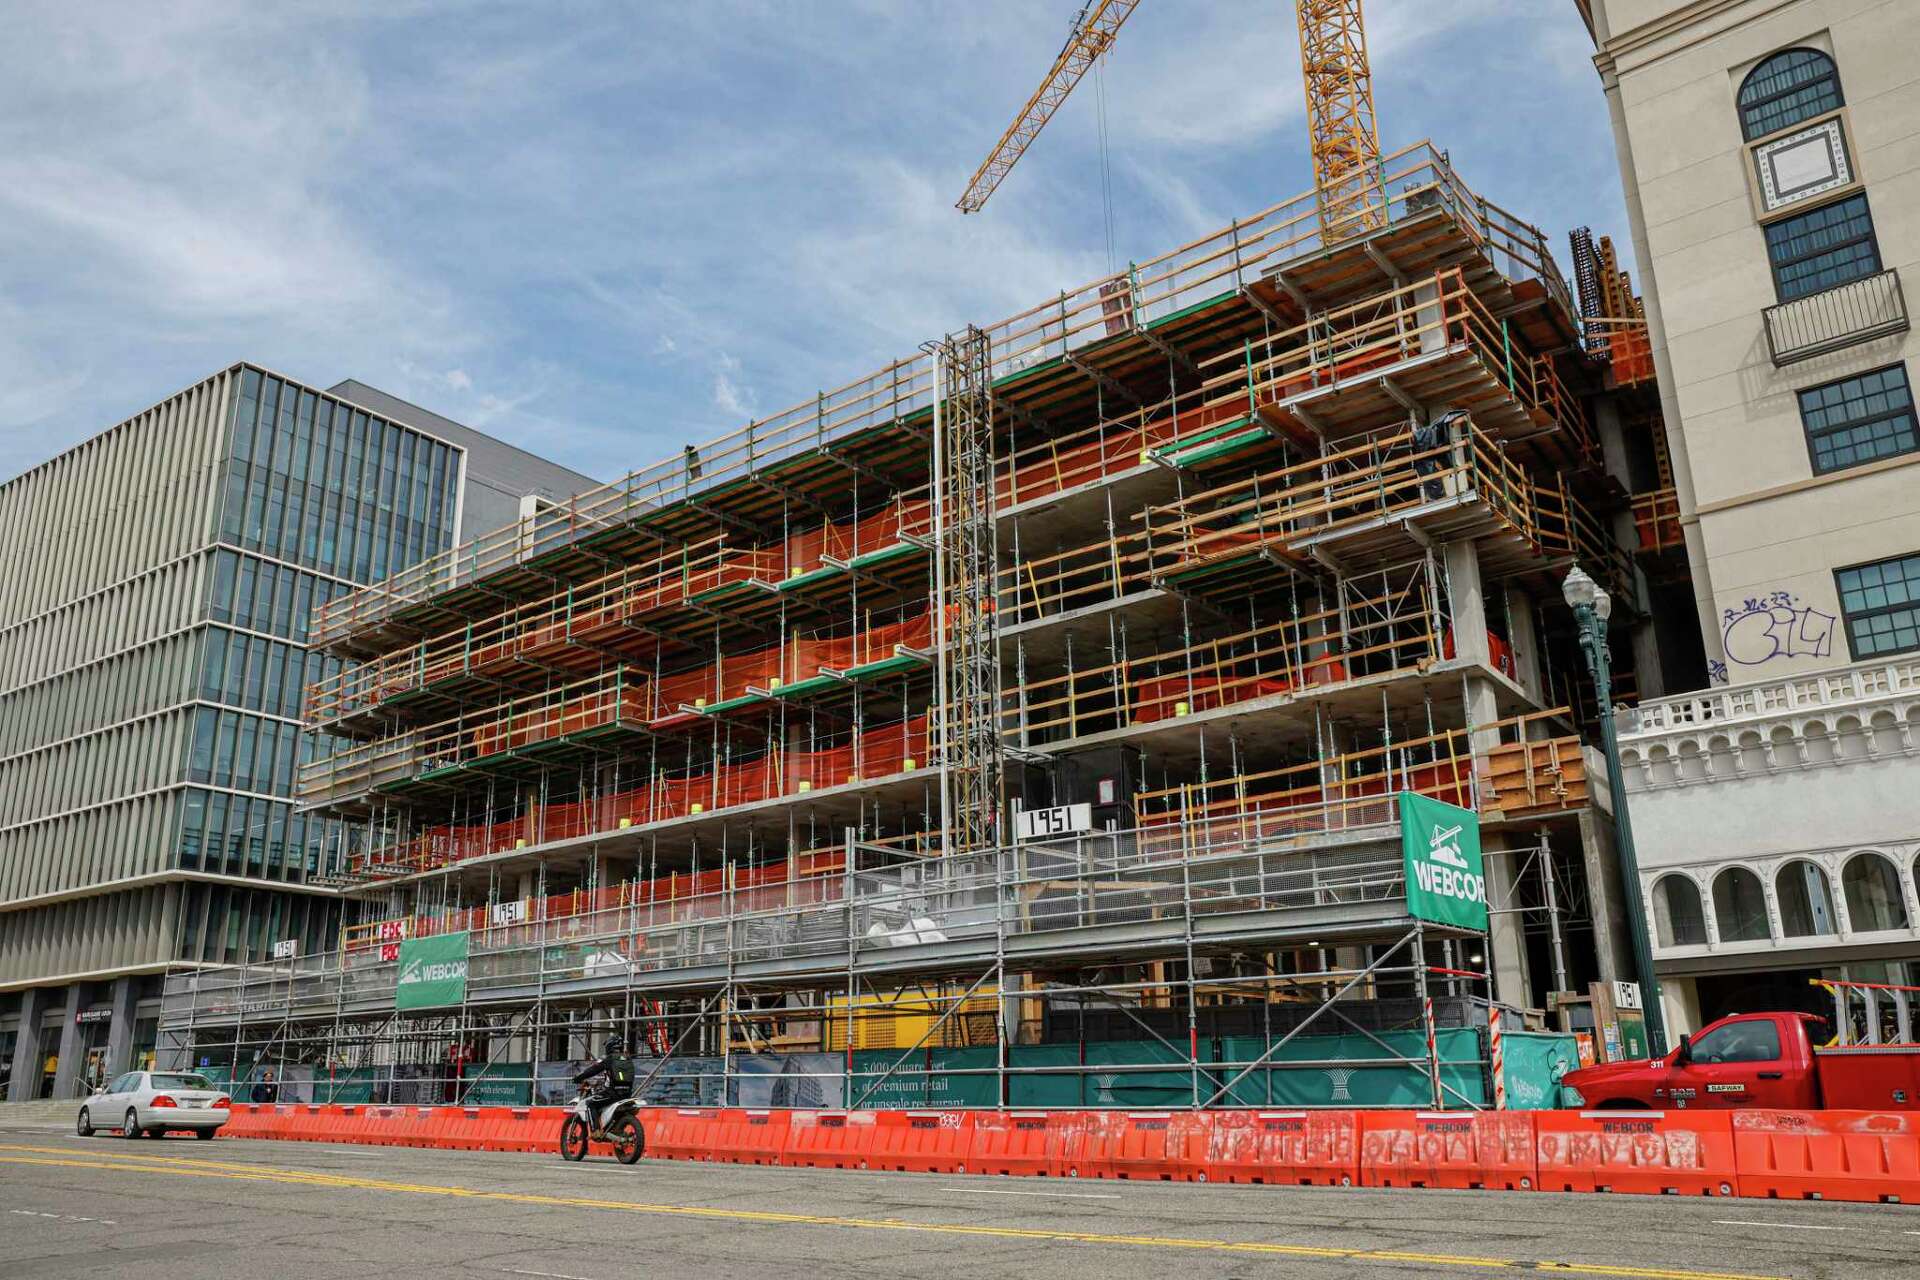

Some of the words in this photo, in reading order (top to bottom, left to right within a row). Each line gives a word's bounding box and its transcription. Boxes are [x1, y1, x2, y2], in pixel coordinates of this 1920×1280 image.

[1030, 807, 1072, 835] 1951
[1413, 860, 1485, 903] WEBCOR
[498, 903, 518, 920] 1951
[423, 961, 467, 981] WEBCOR
[1619, 983, 1636, 1008] 1951
[1651, 1061, 1664, 1069] 311
[874, 1080, 918, 1094] premium
[911, 1098, 964, 1108] resaurant
[1425, 1122, 1471, 1133] WEBCOR
[1602, 1121, 1655, 1134] WEBCOR
